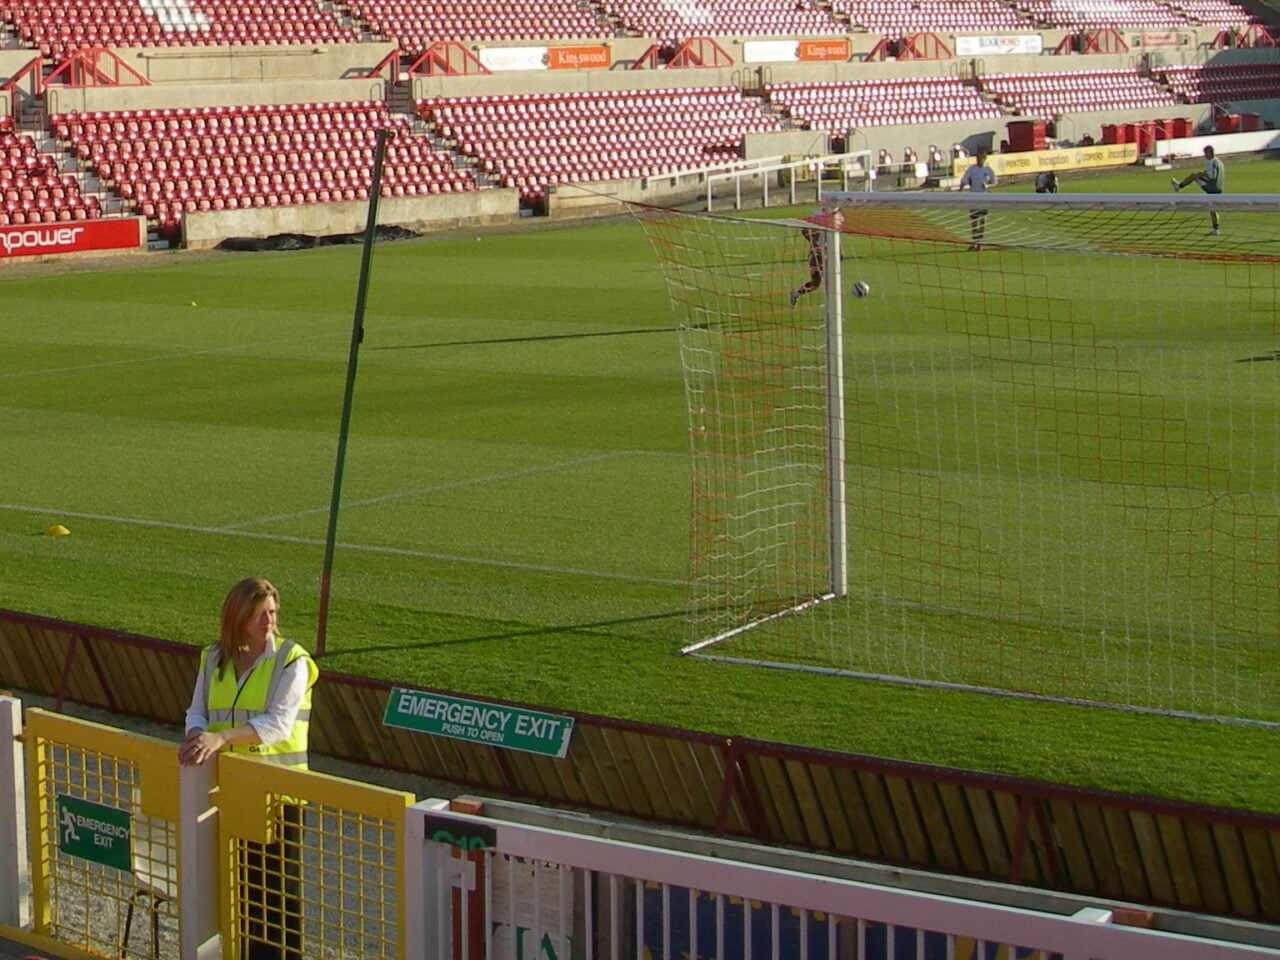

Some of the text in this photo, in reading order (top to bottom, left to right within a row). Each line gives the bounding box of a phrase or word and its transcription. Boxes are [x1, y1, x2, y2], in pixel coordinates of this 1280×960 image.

[558, 50, 607, 67] Kingswood
[398, 696, 561, 740] EMERGENCY EXIT
[441, 724, 504, 742] PUSH TO OPEN
[77, 815, 129, 839] EMERGENCY
[94, 834, 113, 849] EXIT
